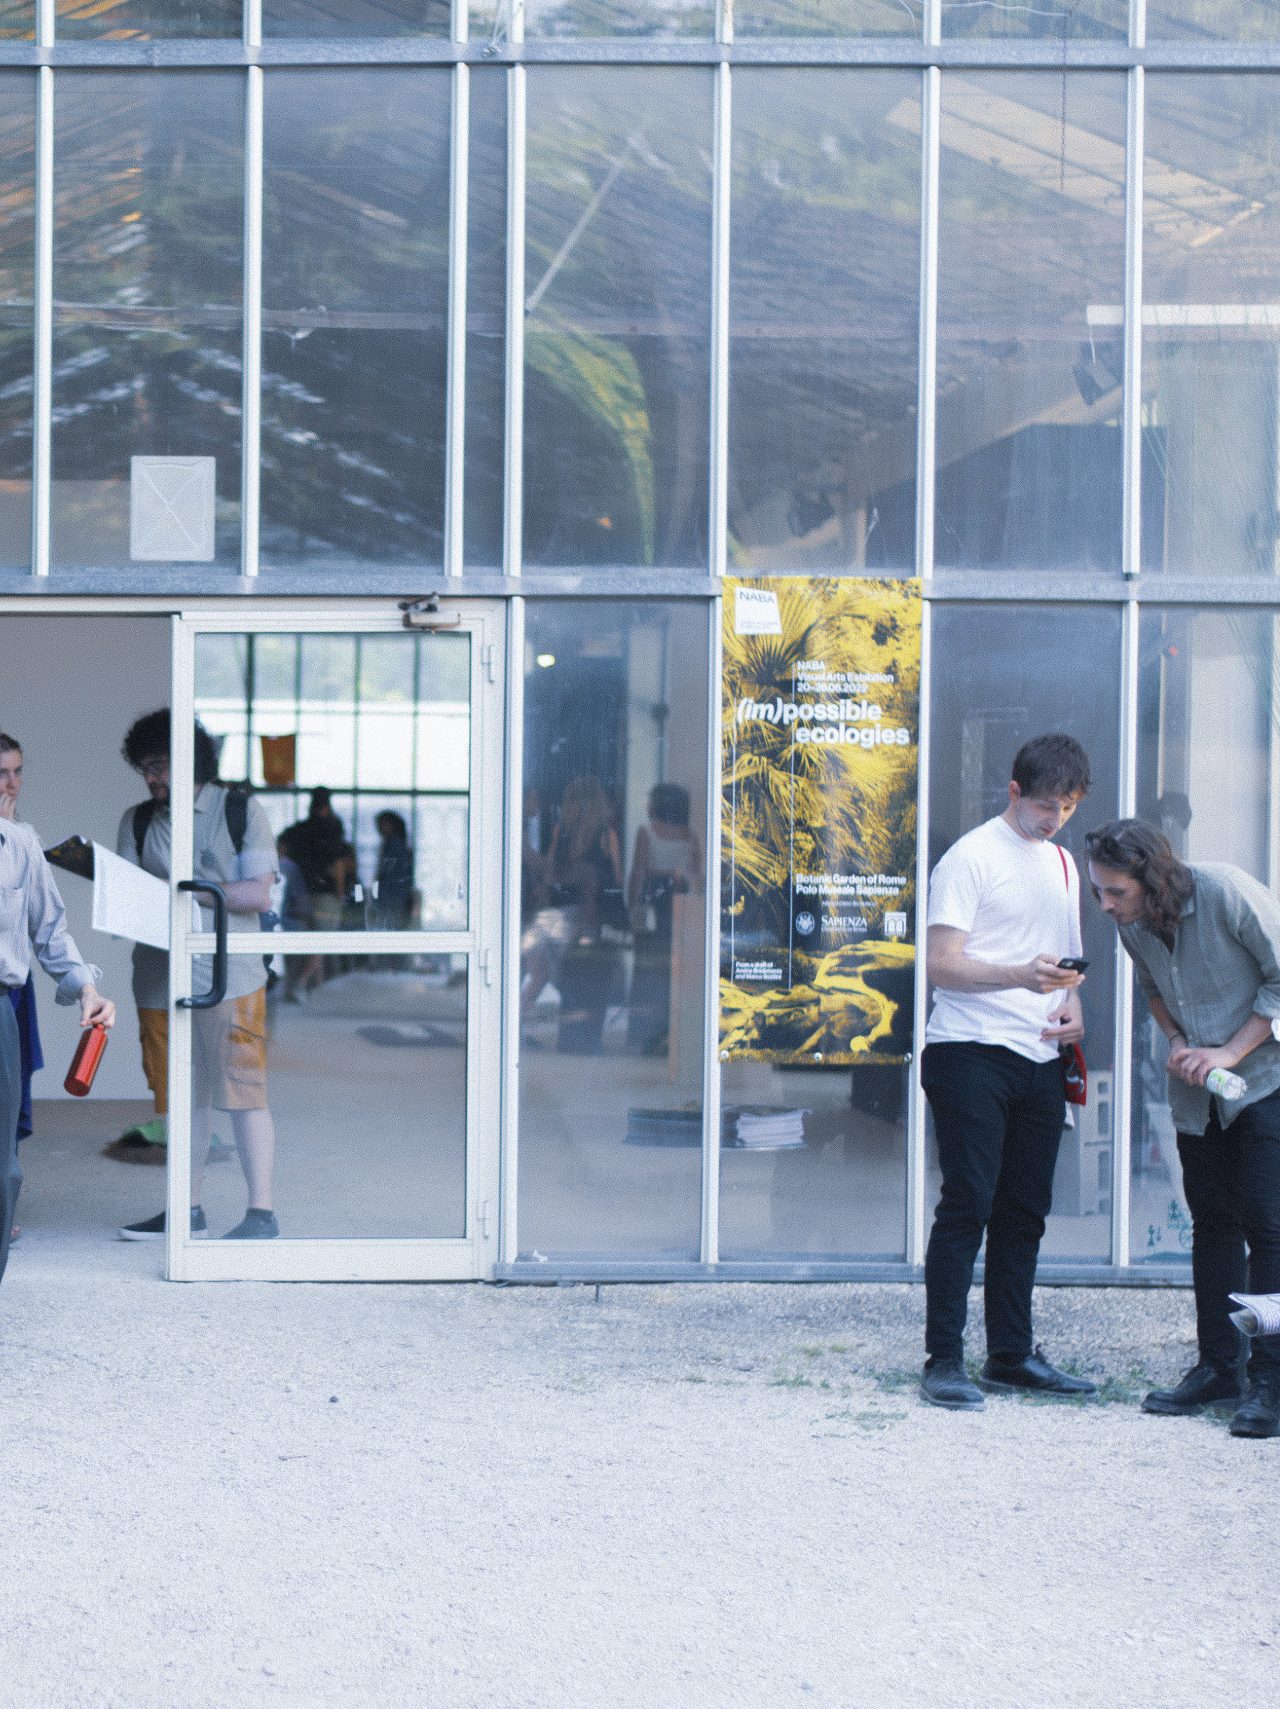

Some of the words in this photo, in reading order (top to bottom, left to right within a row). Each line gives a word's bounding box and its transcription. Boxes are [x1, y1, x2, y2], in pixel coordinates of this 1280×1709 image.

[739, 591, 775, 604] NABA
[796, 660, 825, 670] NABA
[796, 672, 828, 682] Visual
[829, 672, 846, 683] Arts
[847, 672, 894, 683] Exhibition
[737, 697, 882, 725] (im)possible
[795, 722, 910, 749] ecologies
[796, 874, 831, 884] Botanic
[833, 874, 865, 884] Garden
[867, 874, 877, 884] of
[878, 874, 906, 885] Rome
[796, 885, 817, 895] Polo
[856, 886, 899, 896] Sapienza
